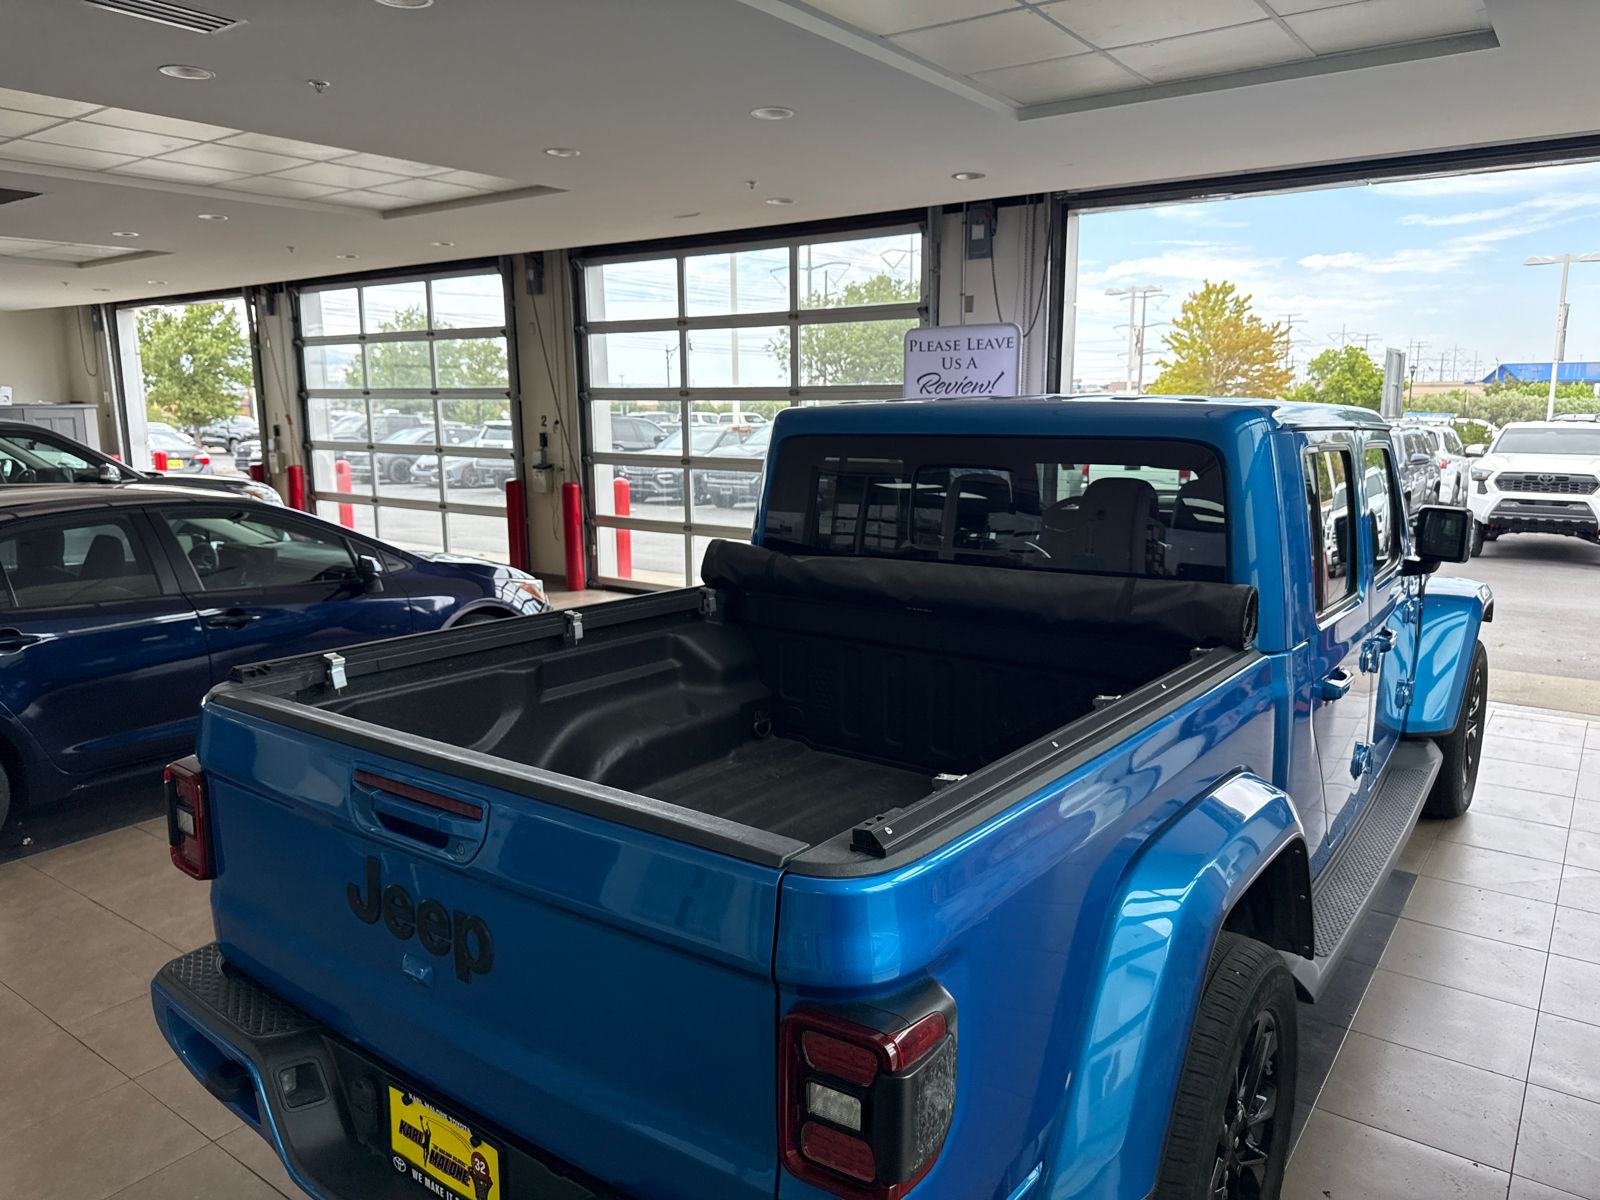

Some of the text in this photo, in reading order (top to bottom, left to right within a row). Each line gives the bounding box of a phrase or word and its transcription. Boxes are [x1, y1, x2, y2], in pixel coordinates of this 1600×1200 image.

[909, 336, 1014, 352] PLEASE LEAVE
[942, 356, 978, 370] US A
[916, 371, 1005, 395] Review!
[541, 415, 547, 427] 2
[346, 855, 493, 984] Jeep
[429, 1148, 470, 1188] MALONE
[474, 1157, 486, 1175] 32
[411, 1168, 454, 1200] WE MAKE IT
